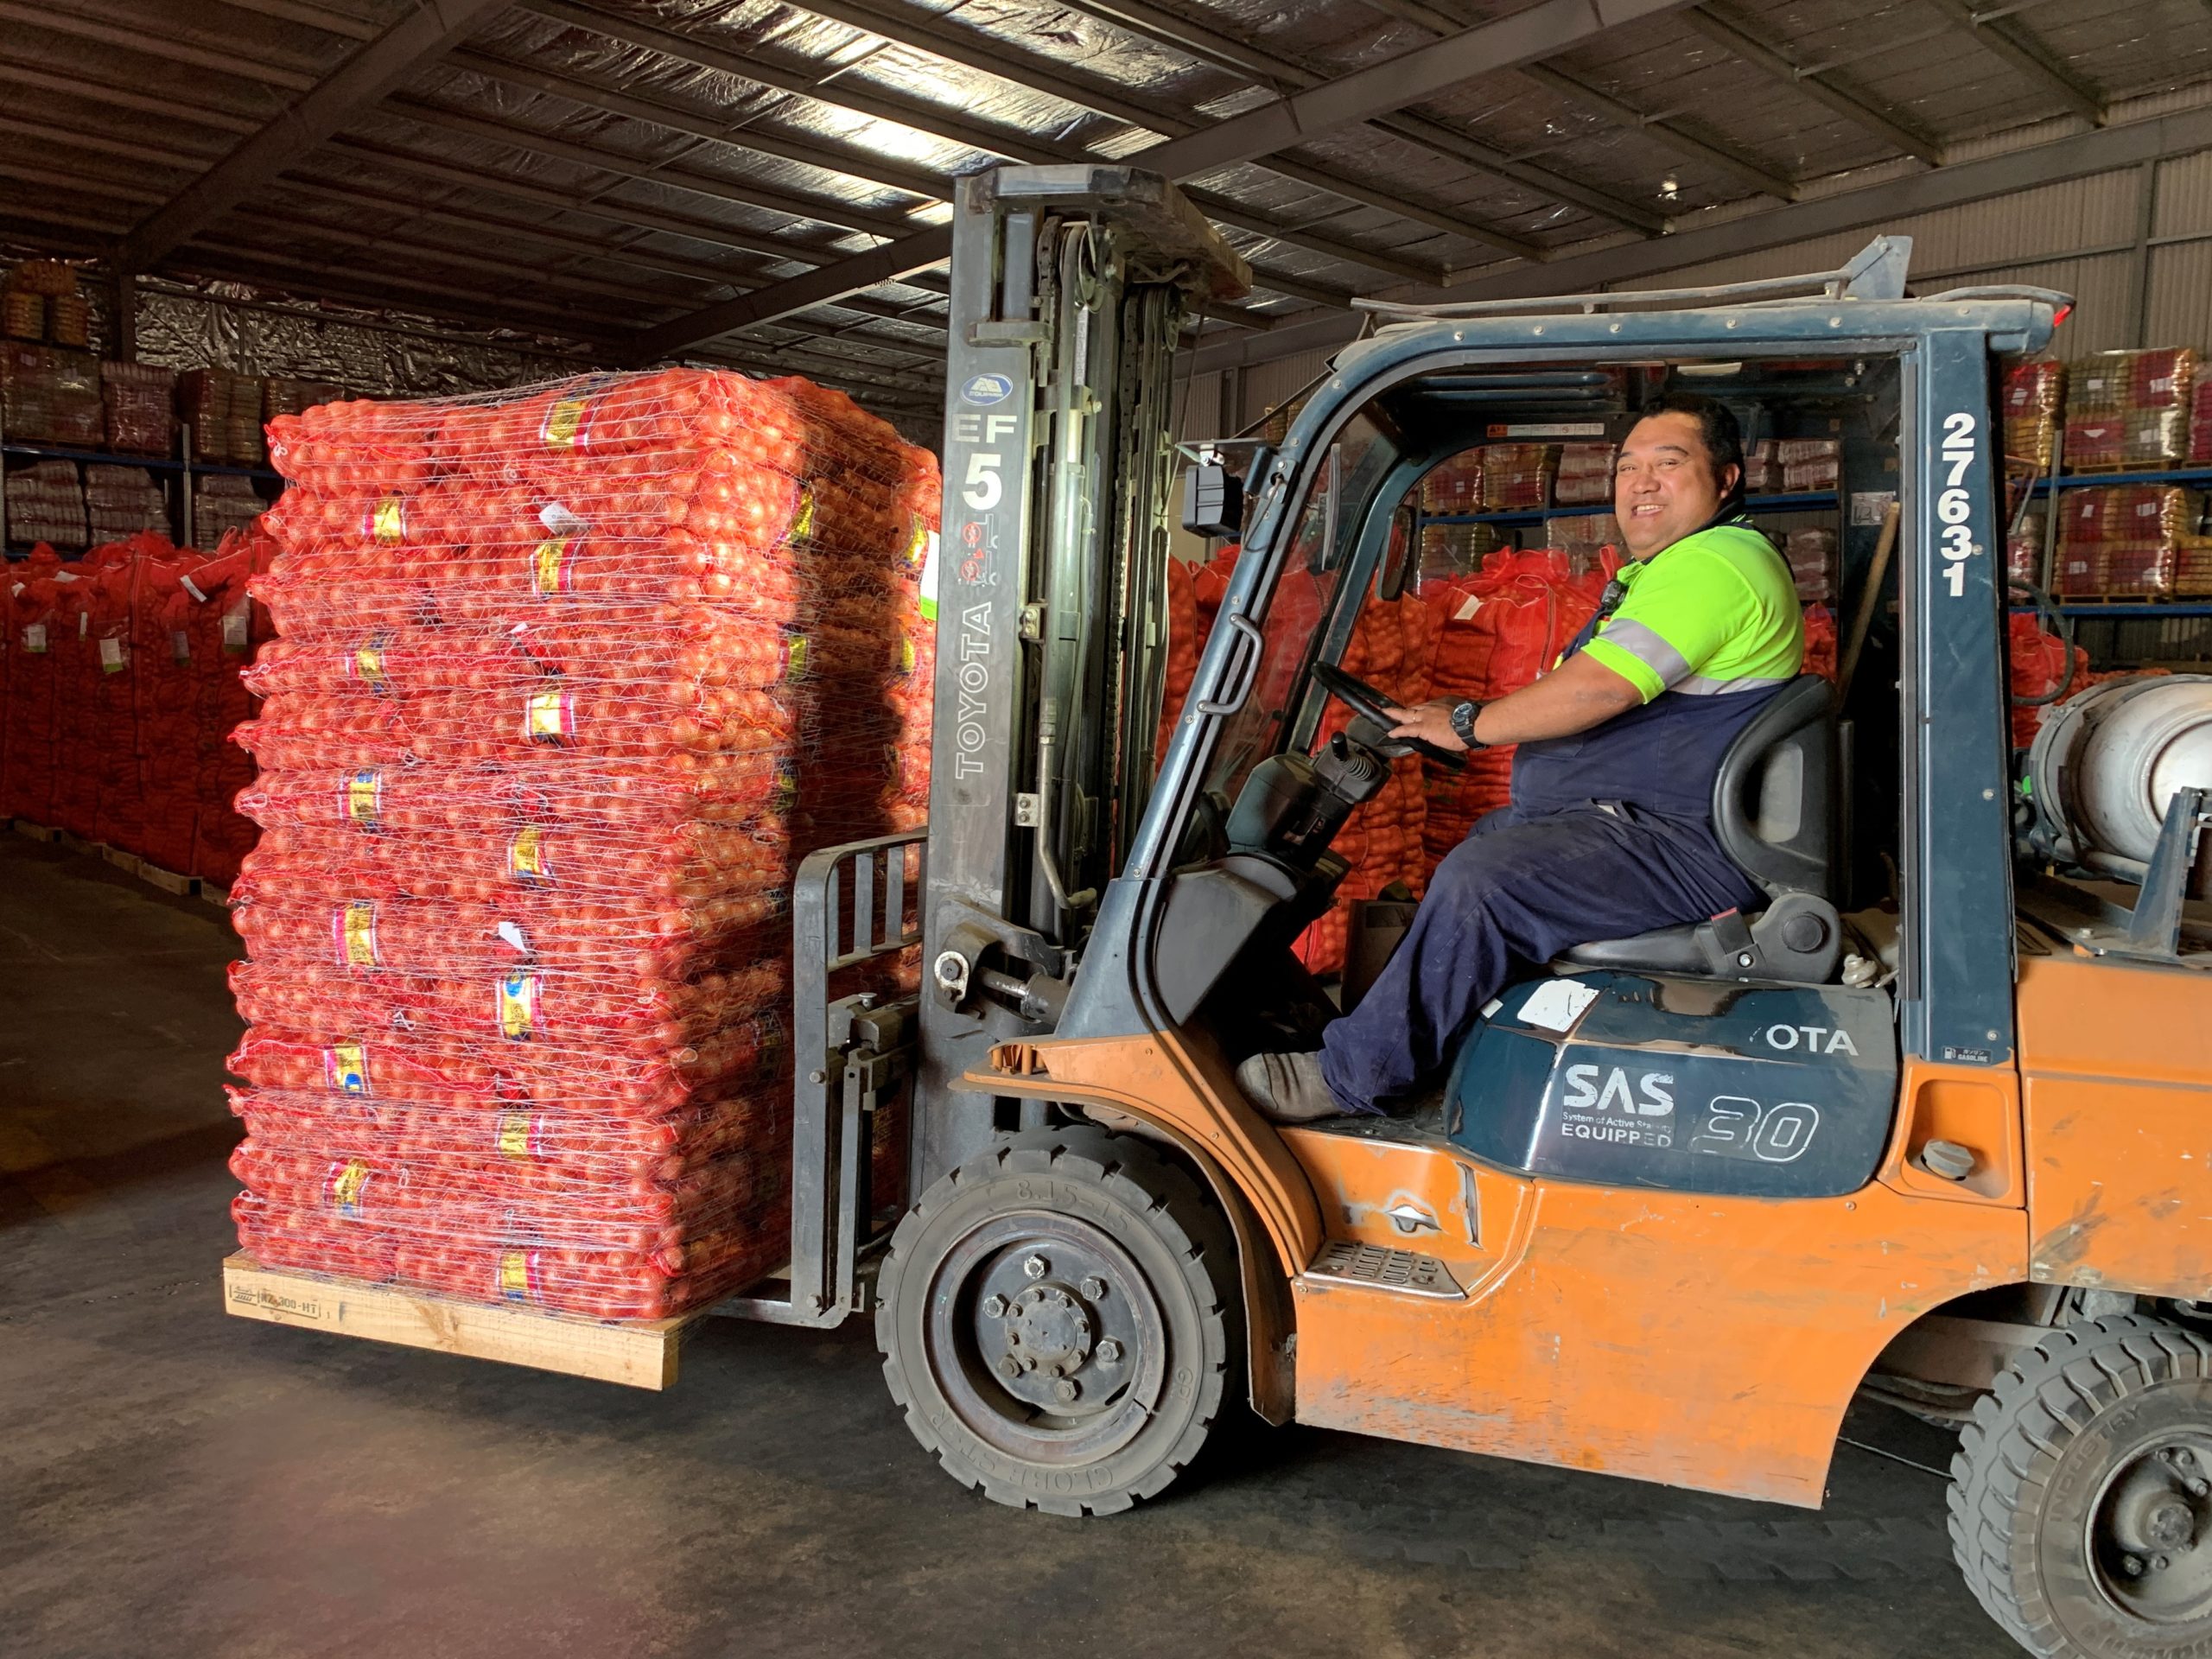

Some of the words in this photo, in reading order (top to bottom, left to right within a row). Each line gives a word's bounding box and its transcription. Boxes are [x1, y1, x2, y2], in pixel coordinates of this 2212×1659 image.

[951, 414, 1018, 444] EF
[962, 454, 1002, 511] 5
[1937, 412, 1975, 597] 27631
[956, 601, 992, 779] TOYOTA
[1750, 1024, 1859, 1056] OTA
[1957, 1054, 1988, 1063] GASOLINE
[1563, 1064, 1675, 1116] SAS
[1561, 1122, 1672, 1147] EQUIPPED
[1562, 1111, 1594, 1123] System
[1606, 1117, 1635, 1128] Active
